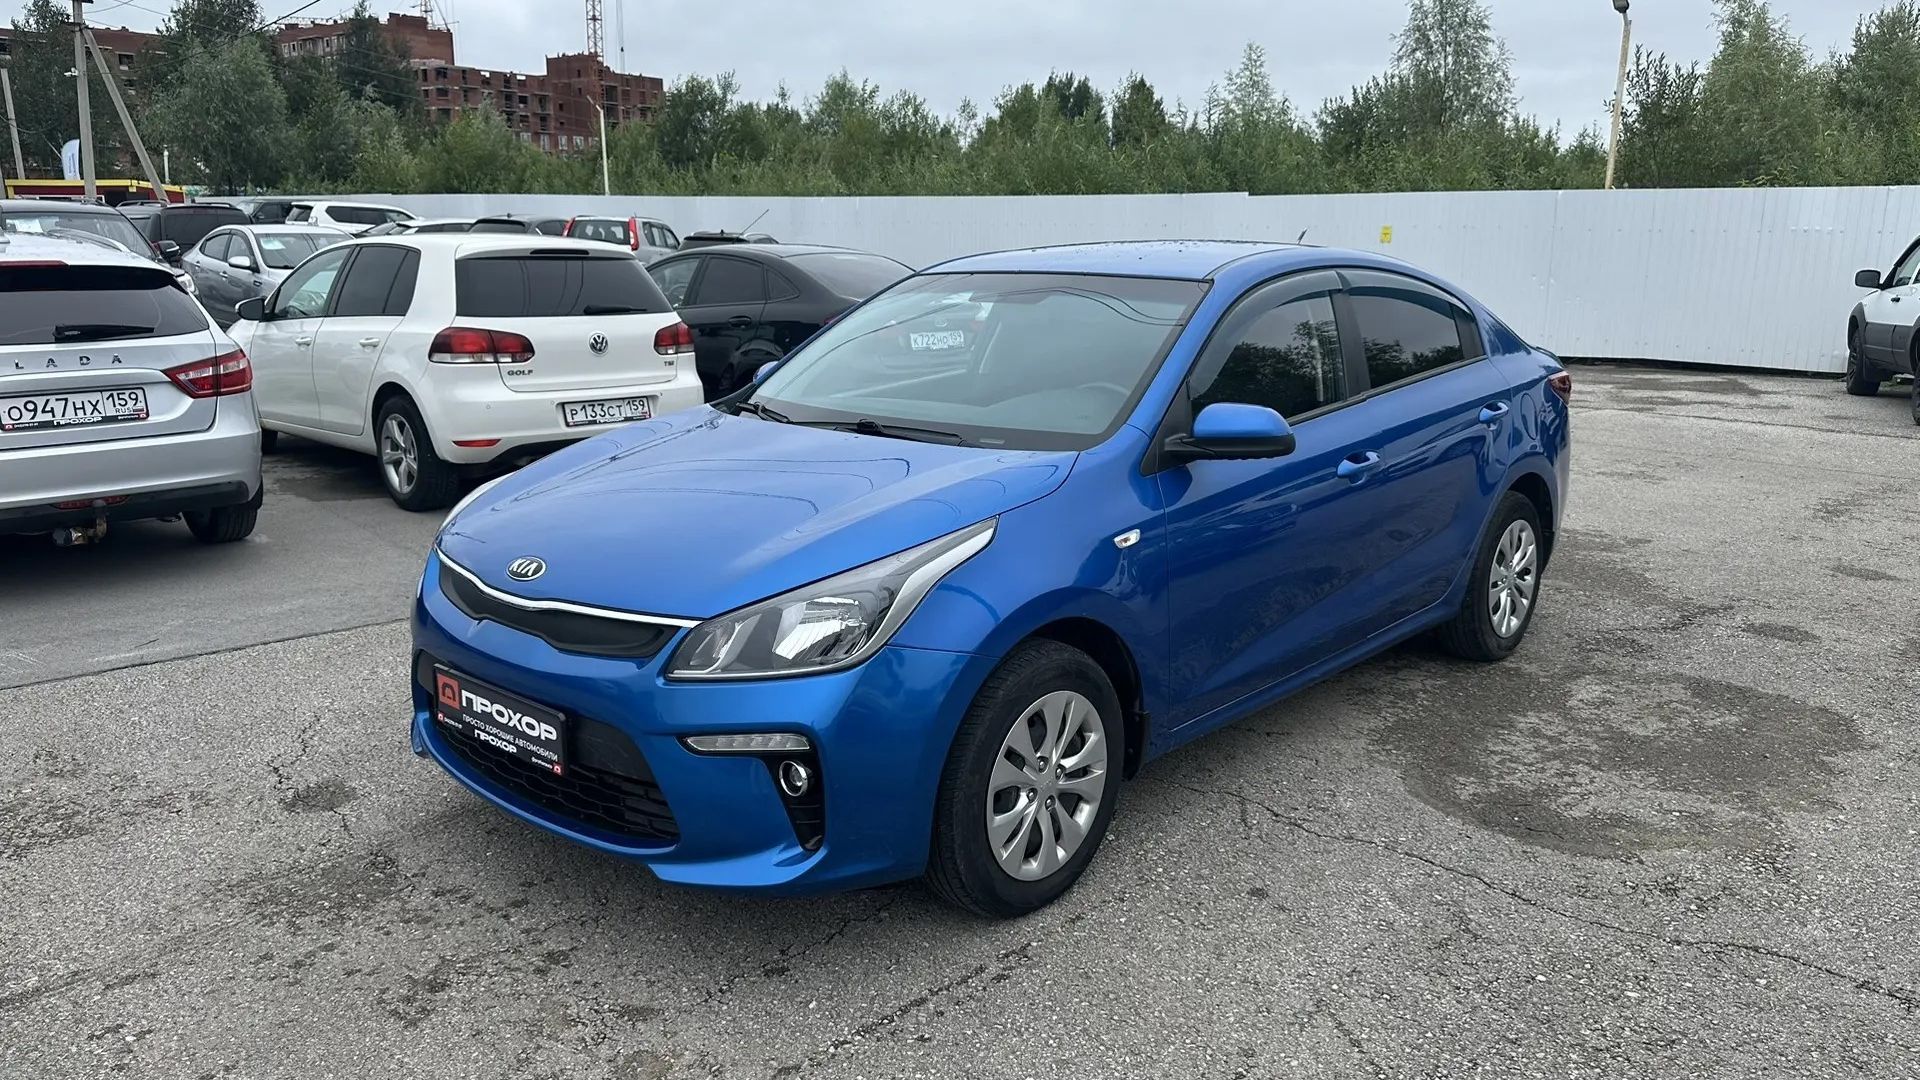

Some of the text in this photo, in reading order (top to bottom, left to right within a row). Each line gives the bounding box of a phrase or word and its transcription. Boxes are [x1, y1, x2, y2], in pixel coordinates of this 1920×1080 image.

[15, 353, 123, 370] LADA
[7, 391, 139, 422] О947НХ 159
[115, 406, 133, 414] RUS
[570, 399, 646, 421] Р133СТ 159
[53, 416, 103, 426] ПРОХОР
[508, 558, 539, 577] KIA
[461, 689, 557, 741] ПРОХОР
[462, 713, 485, 730] ПРОСТО
[485, 724, 515, 743] ХОРОШИЕ
[514, 737, 558, 762] АВТОМОБИЛИ
[474, 729, 518, 753] ПРОХОР
